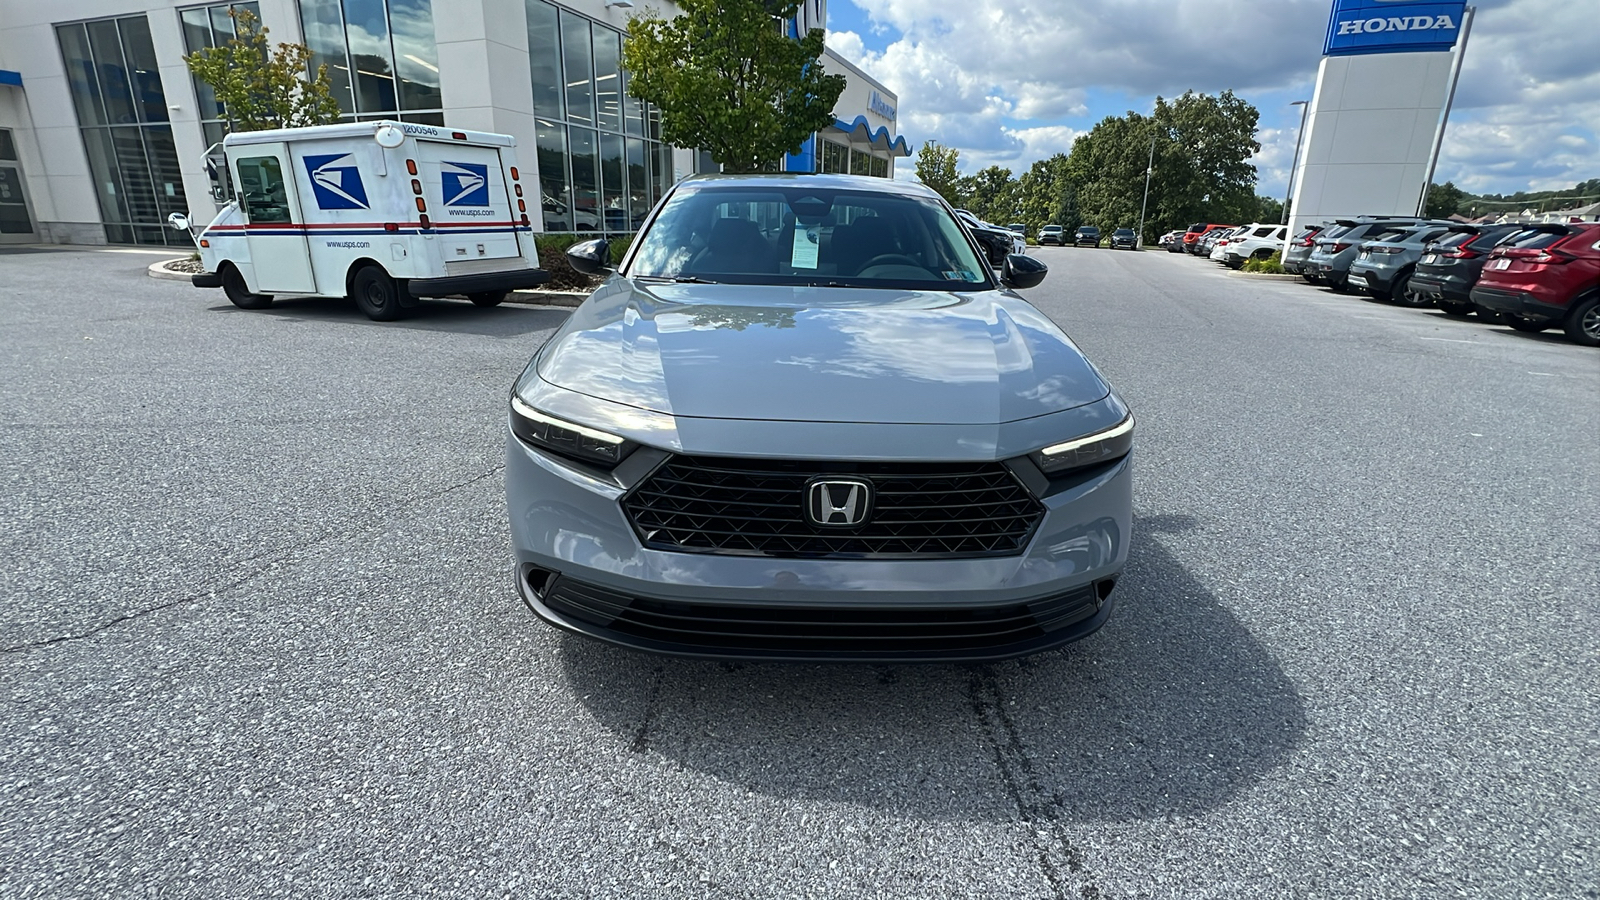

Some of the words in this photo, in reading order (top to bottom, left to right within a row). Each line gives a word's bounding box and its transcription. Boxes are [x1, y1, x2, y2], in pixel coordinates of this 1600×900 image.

[1337, 15, 1456, 35] HONDA
[402, 124, 438, 136] 1200546
[448, 209, 494, 217] www.usps.com
[326, 241, 370, 250] www.usps.com
